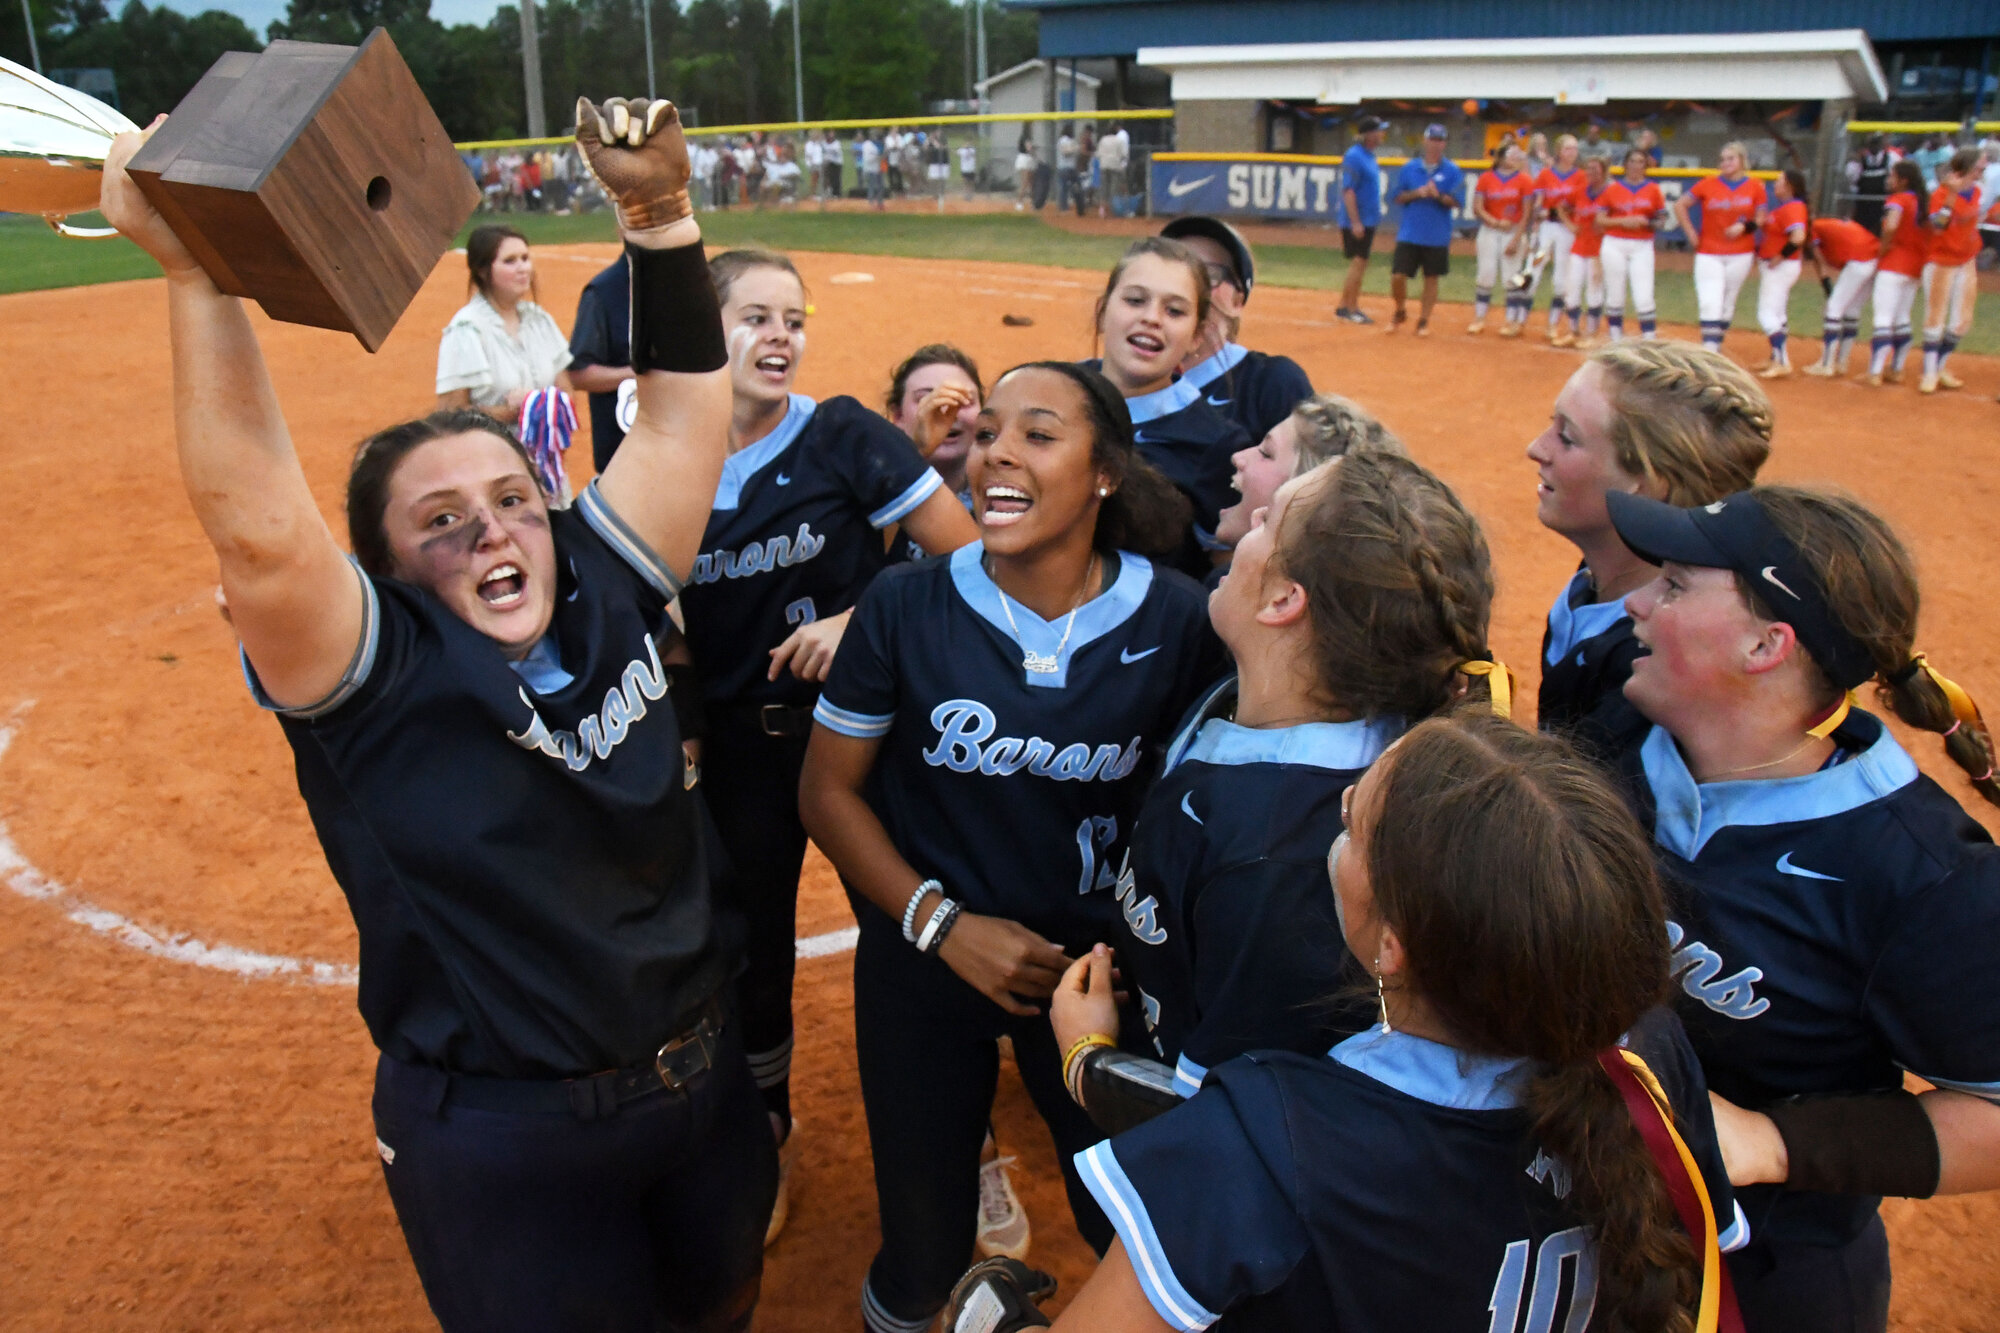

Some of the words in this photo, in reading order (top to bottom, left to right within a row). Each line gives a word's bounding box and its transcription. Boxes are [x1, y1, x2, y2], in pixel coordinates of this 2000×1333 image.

[1227, 164, 1389, 216] SUMT
[692, 523, 826, 584] arons
[922, 699, 1142, 782] Barons
